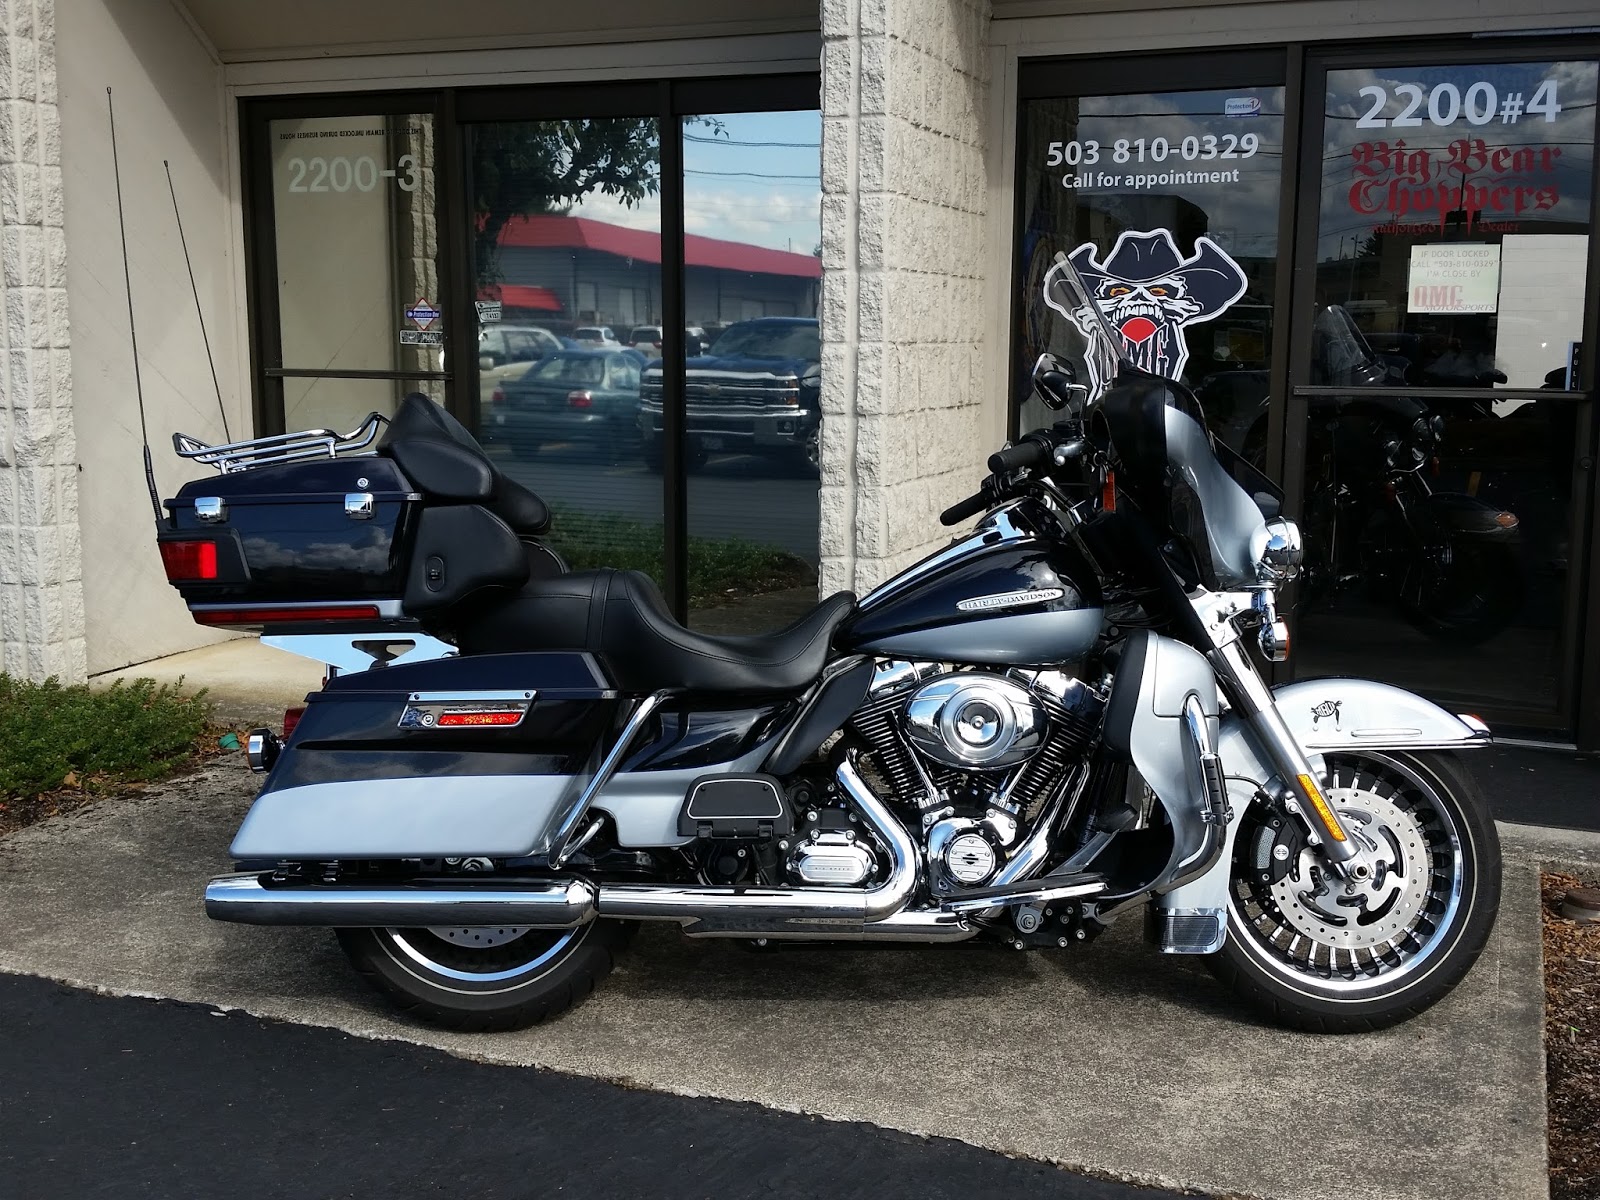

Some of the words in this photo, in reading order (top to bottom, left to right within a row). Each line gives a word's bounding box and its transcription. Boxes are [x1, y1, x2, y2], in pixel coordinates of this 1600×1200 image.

[1355, 79, 1562, 129] 2200#4
[1046, 140, 1100, 167] 503
[1112, 133, 1260, 164] 810-0329
[1351, 138, 1432, 186] Big
[1446, 138, 1562, 176] Bear
[287, 154, 421, 193] 2200-3
[1062, 173, 1093, 189] Call
[1097, 172, 1122, 187] for
[1124, 169, 1240, 190] appointment
[1349, 177, 1560, 235] Choppers
[1410, 260, 1431, 268] CALL
[1421, 250, 1429, 258] IF
[1431, 250, 1455, 258] DOOR
[1457, 250, 1490, 258] LOCKED
[1442, 270, 1468, 278] CLOSE
[1470, 270, 1481, 278] BY
[1423, 303, 1496, 312] MOTORSPORTS
[964, 591, 1057, 609] HARLEY-DAVIDSON
